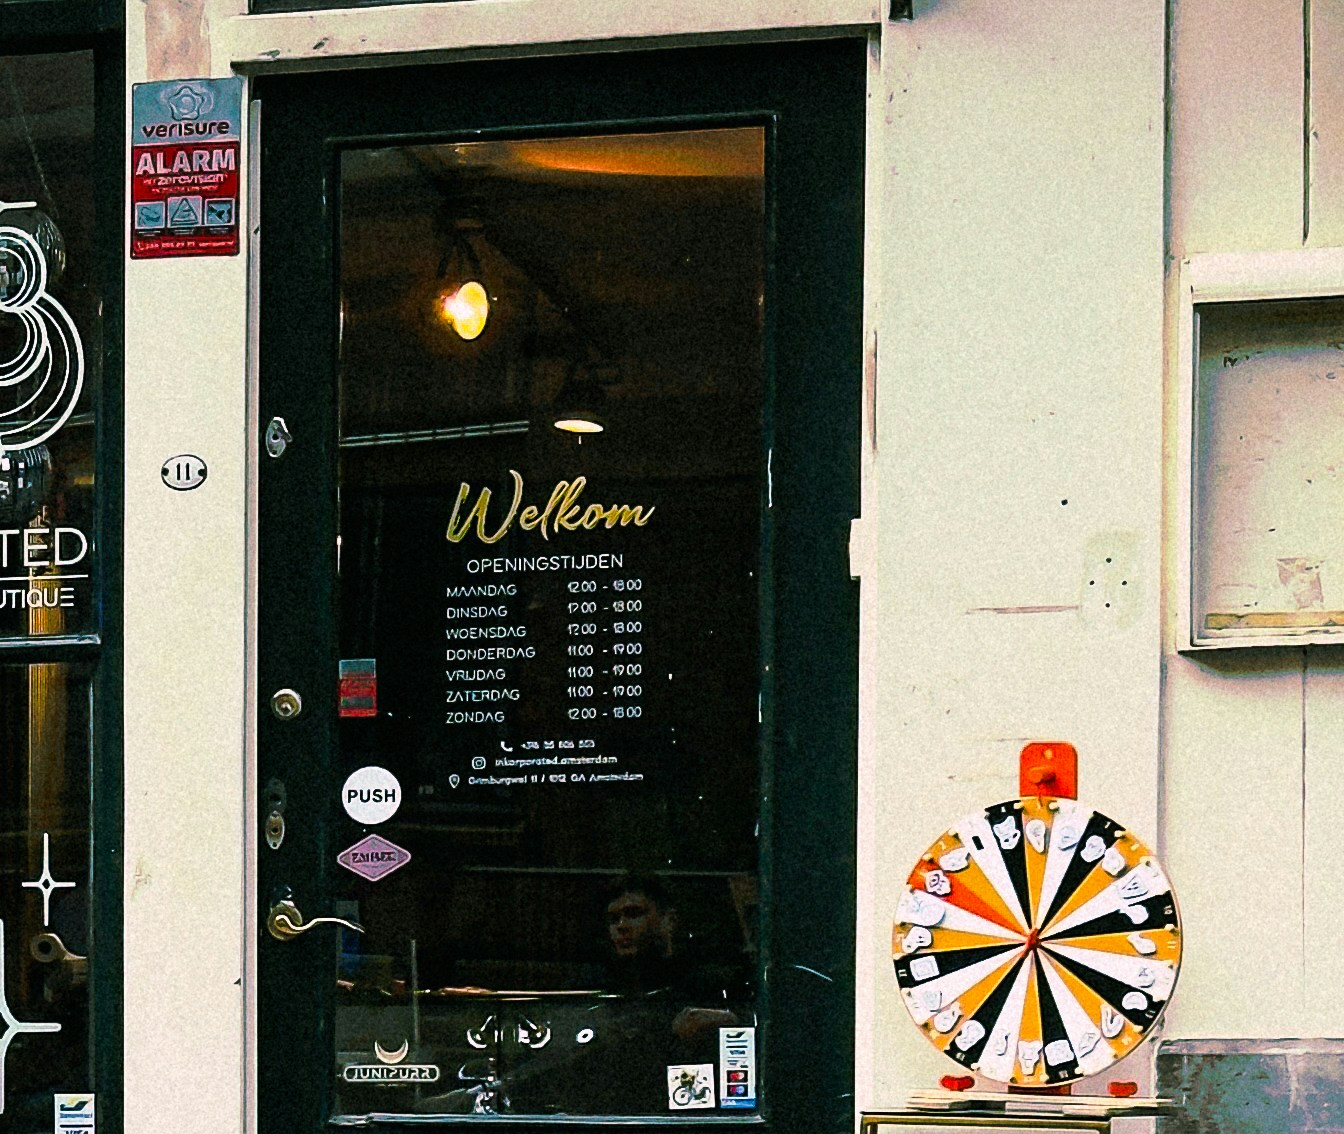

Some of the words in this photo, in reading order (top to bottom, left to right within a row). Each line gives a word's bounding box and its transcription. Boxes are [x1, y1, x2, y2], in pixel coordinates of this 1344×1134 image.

[143, 121, 230, 138] verisure
[136, 149, 236, 176] ALARM
[176, 462, 191, 481] 11
[446, 469, 656, 544] Welkom
[467, 553, 624, 574] OPENINGSTIJDEN
[446, 584, 517, 598] MAANDAG
[446, 606, 508, 619] DINSDAG
[446, 626, 527, 640] WOENSDAG
[446, 647, 536, 661] DONDERDAG
[446, 668, 506, 682] VRIJDAG
[446, 689, 520, 703] ZATERDAG
[446, 711, 505, 724] ZONDAG
[347, 789, 396, 803] PUSH
